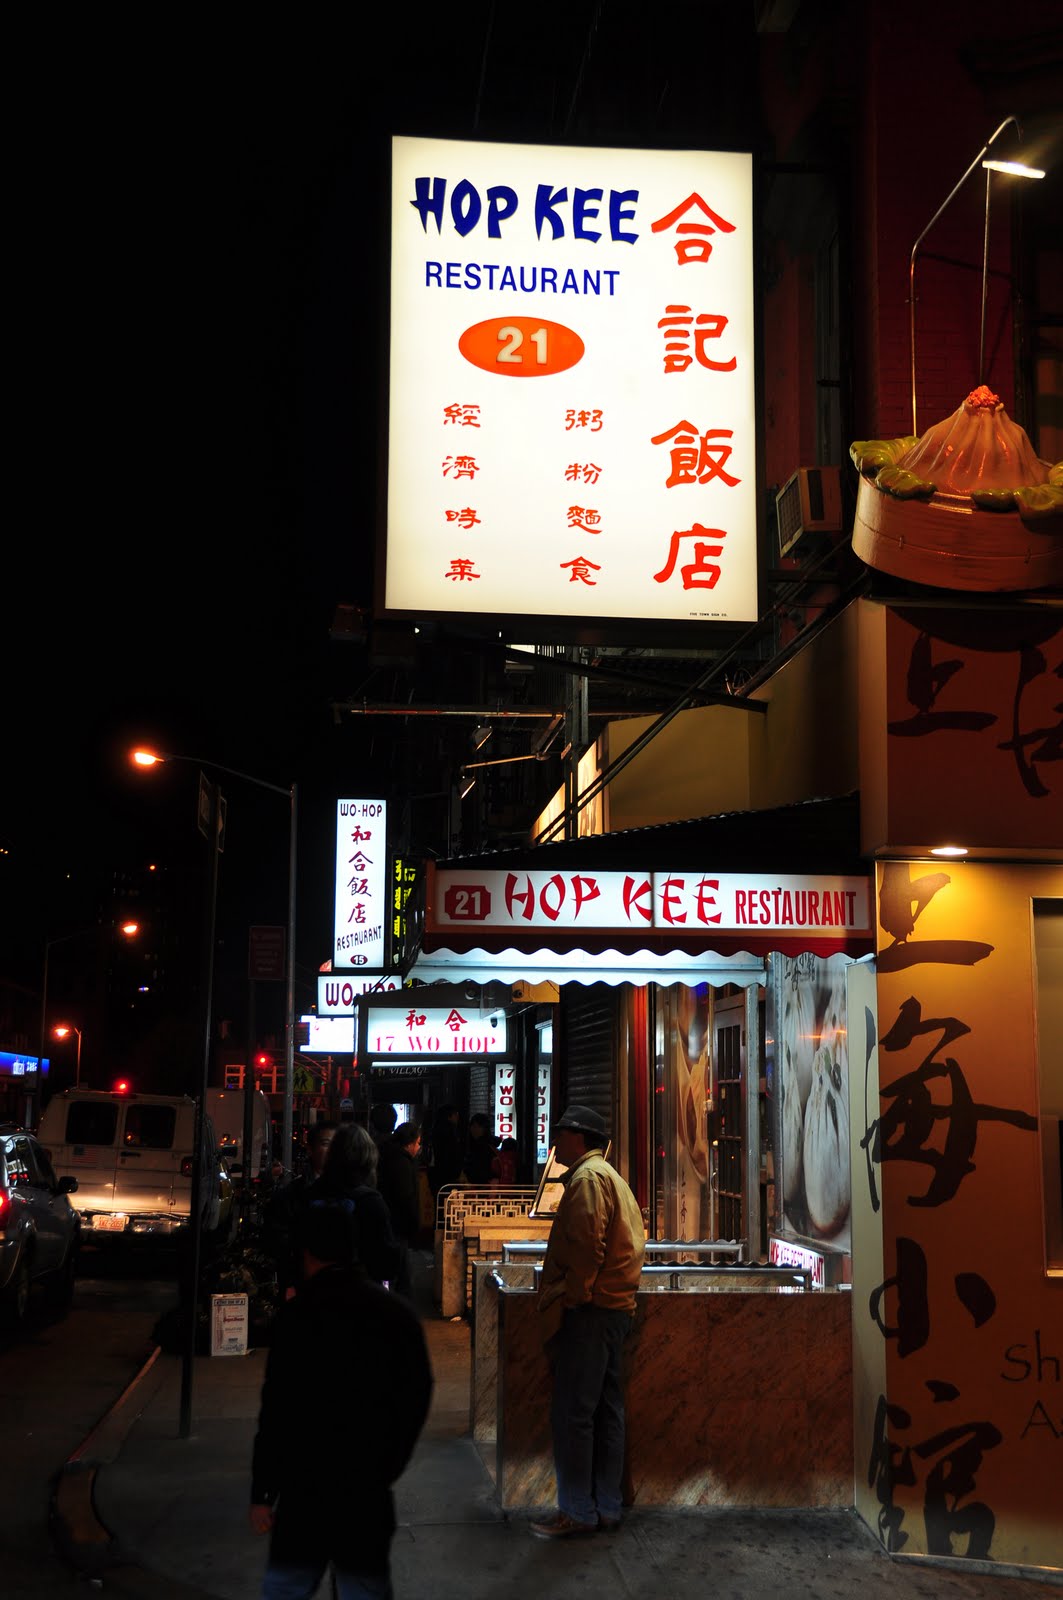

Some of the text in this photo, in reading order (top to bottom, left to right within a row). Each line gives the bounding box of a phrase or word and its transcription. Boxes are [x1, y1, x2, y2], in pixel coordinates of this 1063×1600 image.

[410, 177, 640, 244] HOP KEE
[425, 261, 620, 296] RESTAURANT
[496, 325, 549, 364] 21
[651, 191, 742, 590] 合記飯店
[340, 803, 383, 818] WO-HOP
[346, 824, 374, 924] 和合飯店
[455, 890, 482, 915] 21
[505, 872, 601, 922] HOP
[622, 873, 722, 927] KEE
[735, 888, 857, 927] RESTAURANT
[336, 925, 383, 951] RESTAURANT
[354, 956, 364, 965] 15
[405, 1008, 468, 1032] 和合
[376, 1036, 496, 1053] 17 WO HOP
[498, 1068, 515, 1079] 17
[499, 1085, 513, 1106] WO
